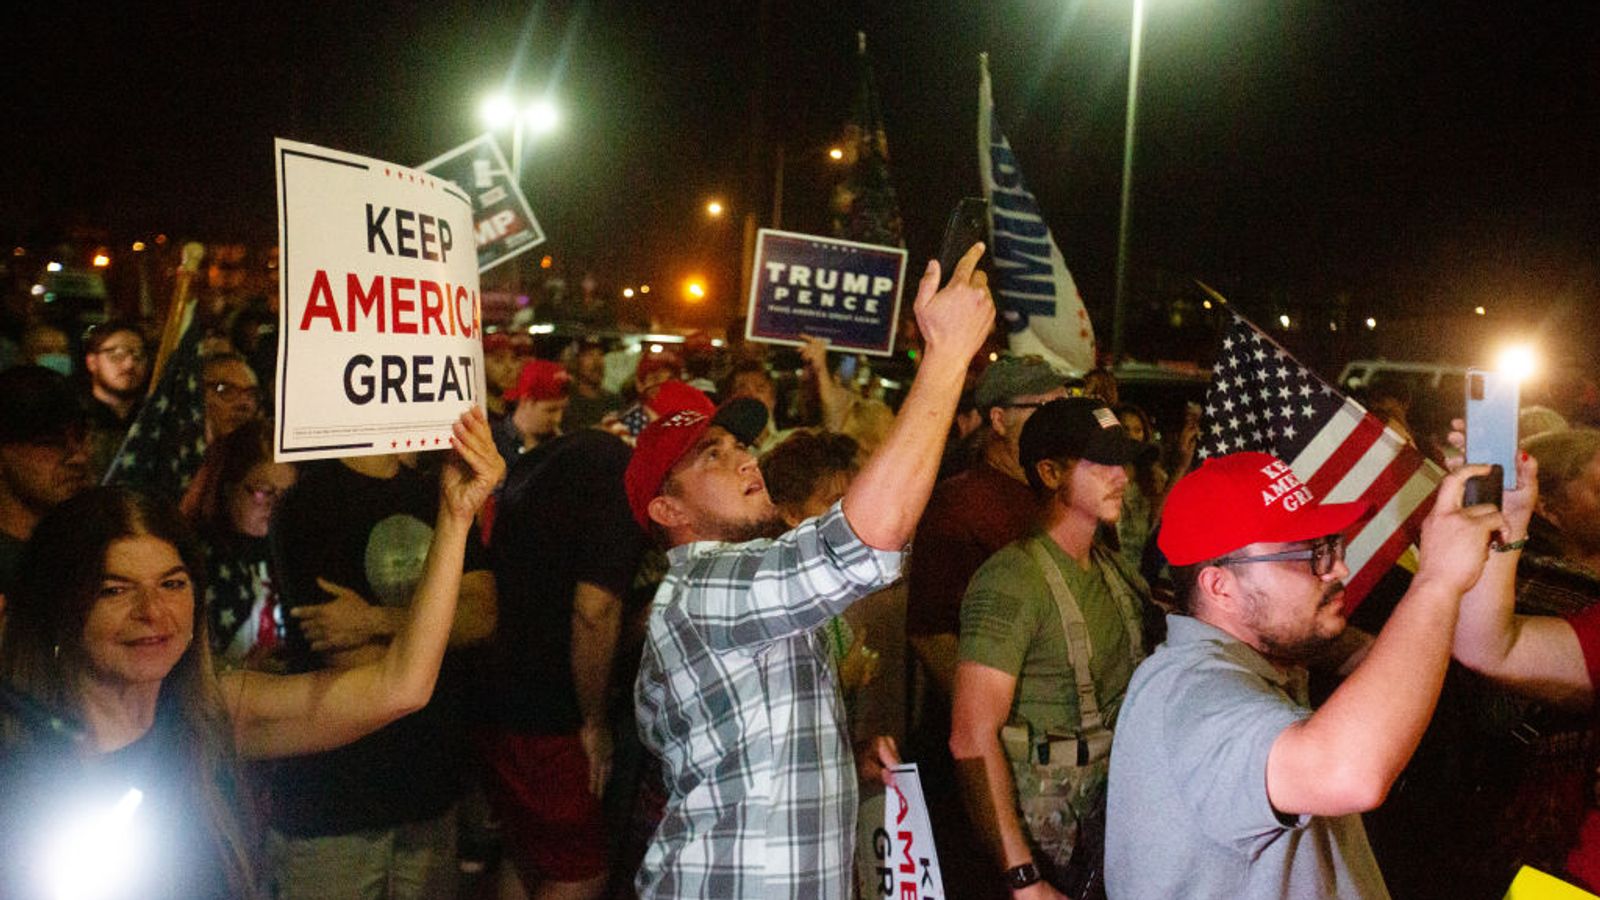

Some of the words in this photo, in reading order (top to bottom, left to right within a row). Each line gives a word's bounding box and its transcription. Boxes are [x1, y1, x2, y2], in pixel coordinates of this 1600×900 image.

[365, 203, 453, 263] KEEP
[765, 260, 893, 297] TRUMP
[774, 286, 879, 314] PENCE
[299, 269, 480, 339] AMERICA
